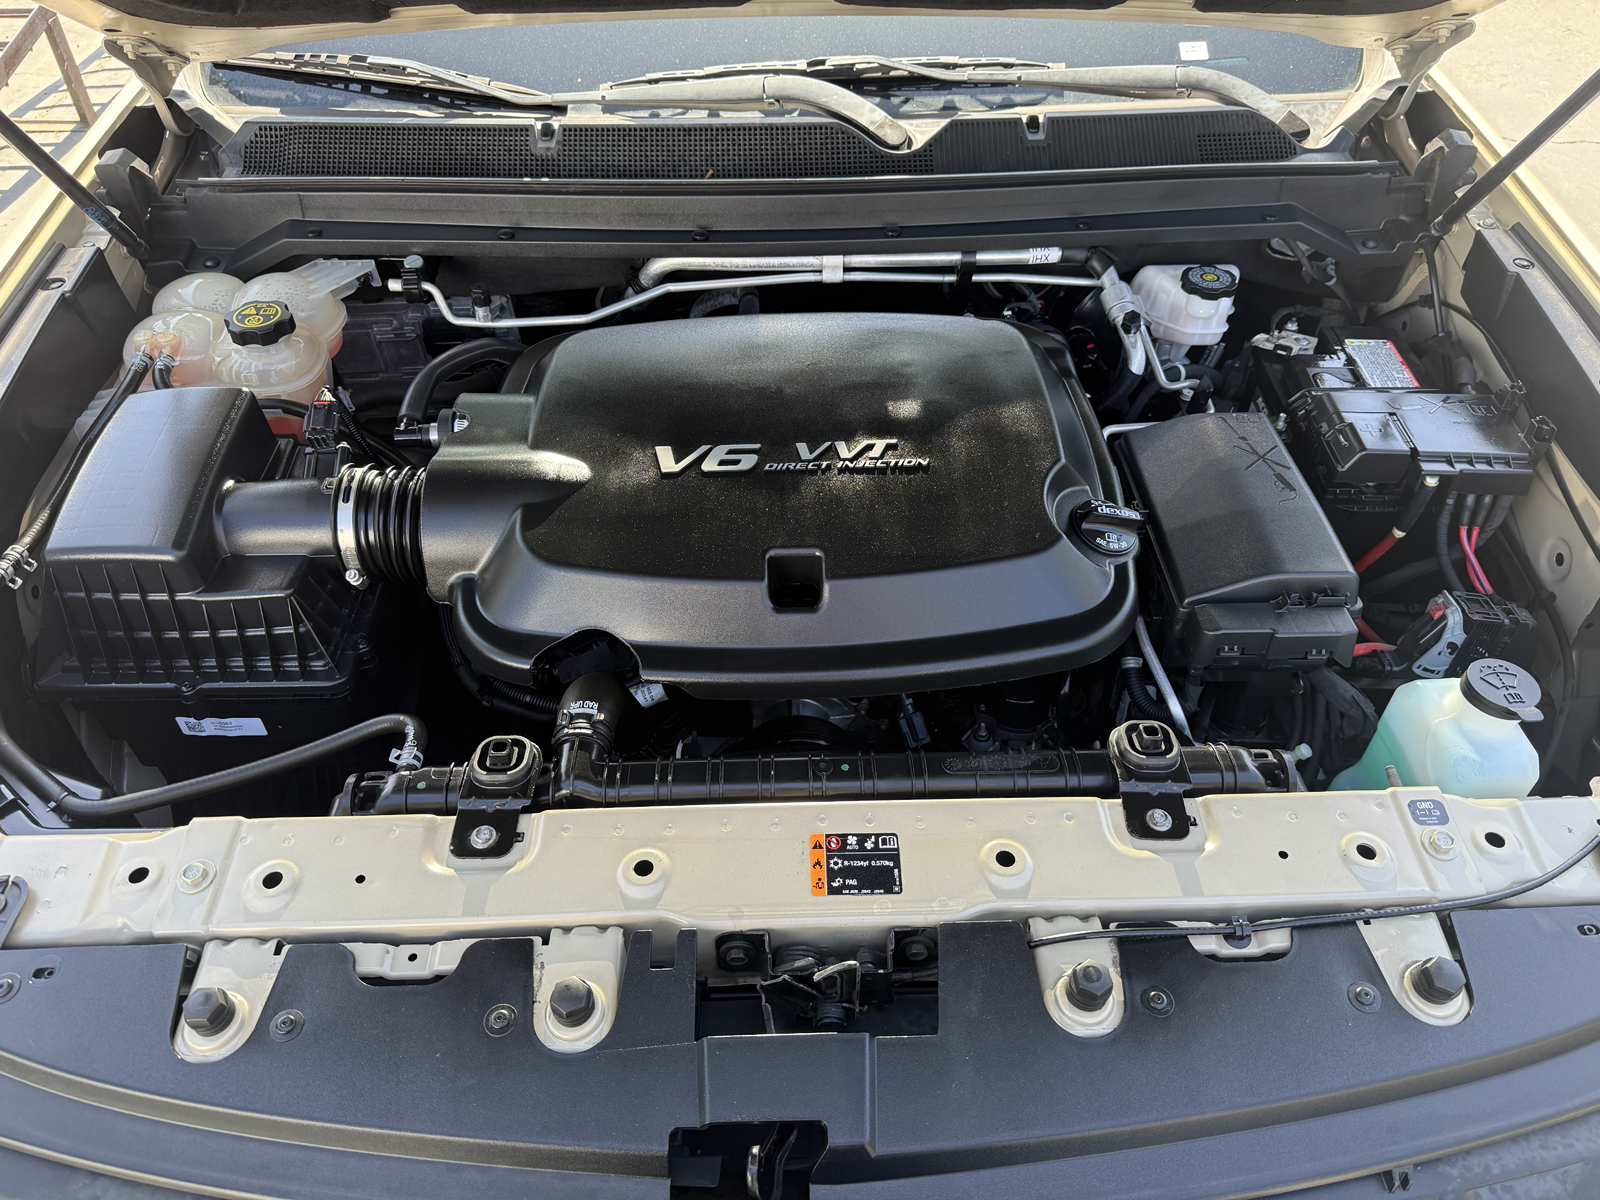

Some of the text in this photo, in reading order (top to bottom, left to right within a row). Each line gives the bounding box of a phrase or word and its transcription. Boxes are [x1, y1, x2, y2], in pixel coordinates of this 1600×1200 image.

[1032, 253, 1051, 263] IHX
[654, 439, 898, 475] V6 VVT
[763, 457, 930, 471] DIRECT INJECTION
[1095, 537, 1108, 547] SAE
[583, 700, 599, 709] RAD
[1416, 801, 1434, 809] GND
[843, 860, 869, 868] R-1234yf
